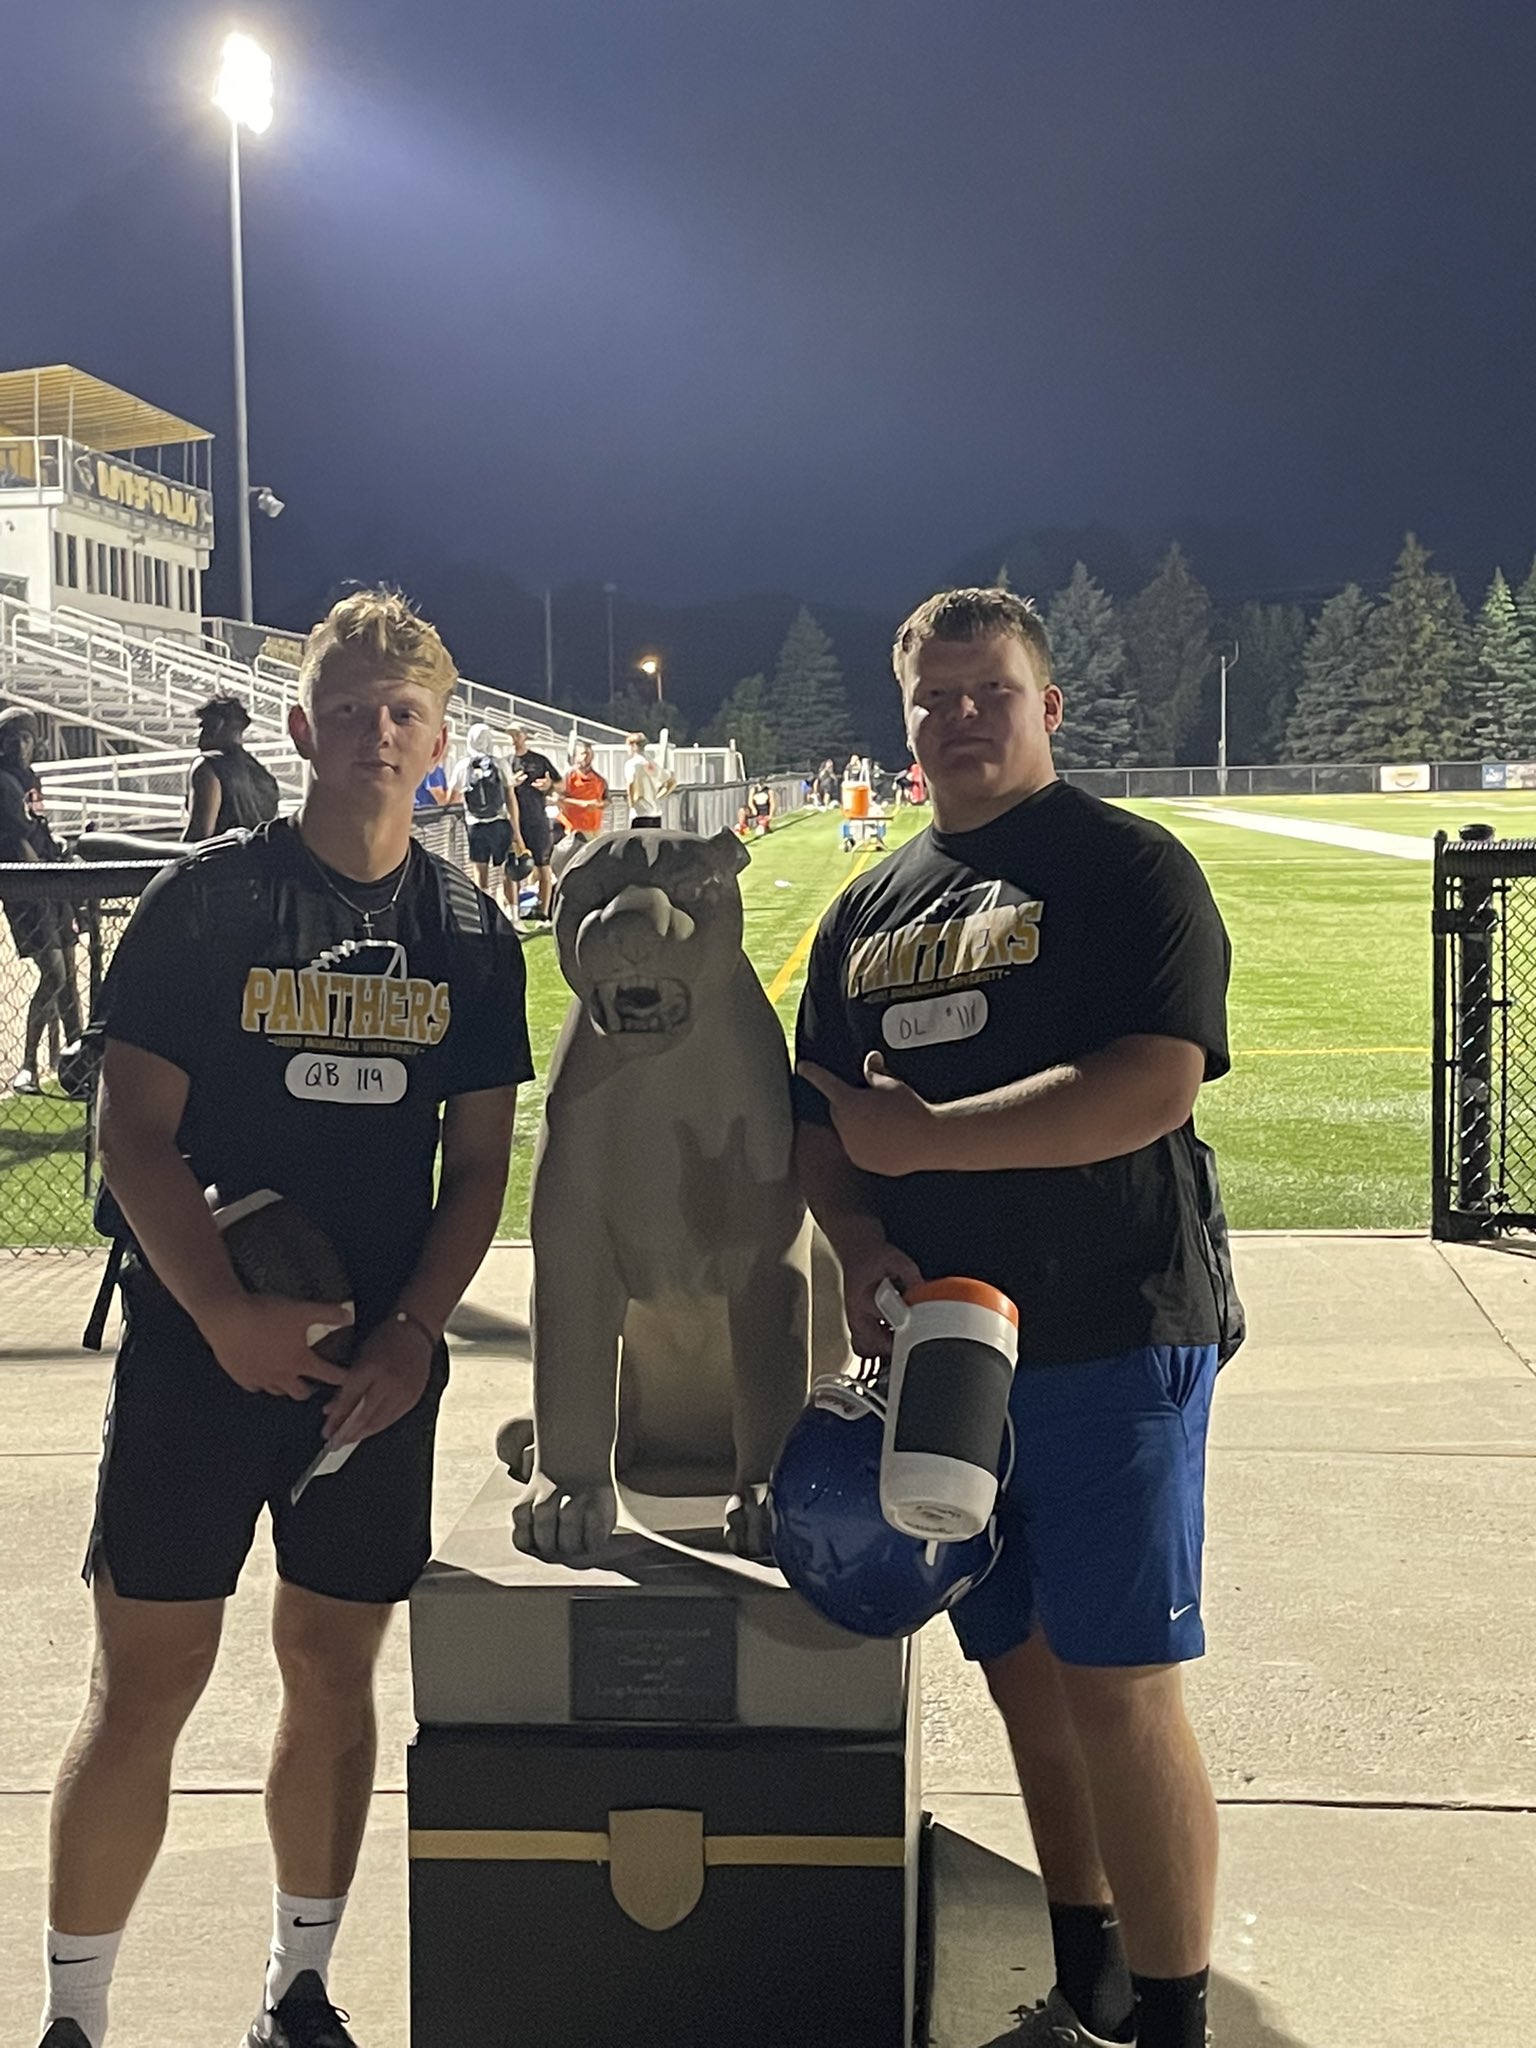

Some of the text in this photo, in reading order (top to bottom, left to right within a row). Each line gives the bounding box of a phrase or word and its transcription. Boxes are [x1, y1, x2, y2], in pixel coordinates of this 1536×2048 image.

[241, 967, 451, 1044] PANTHERS
[305, 1062, 383, 1092] QB 119
